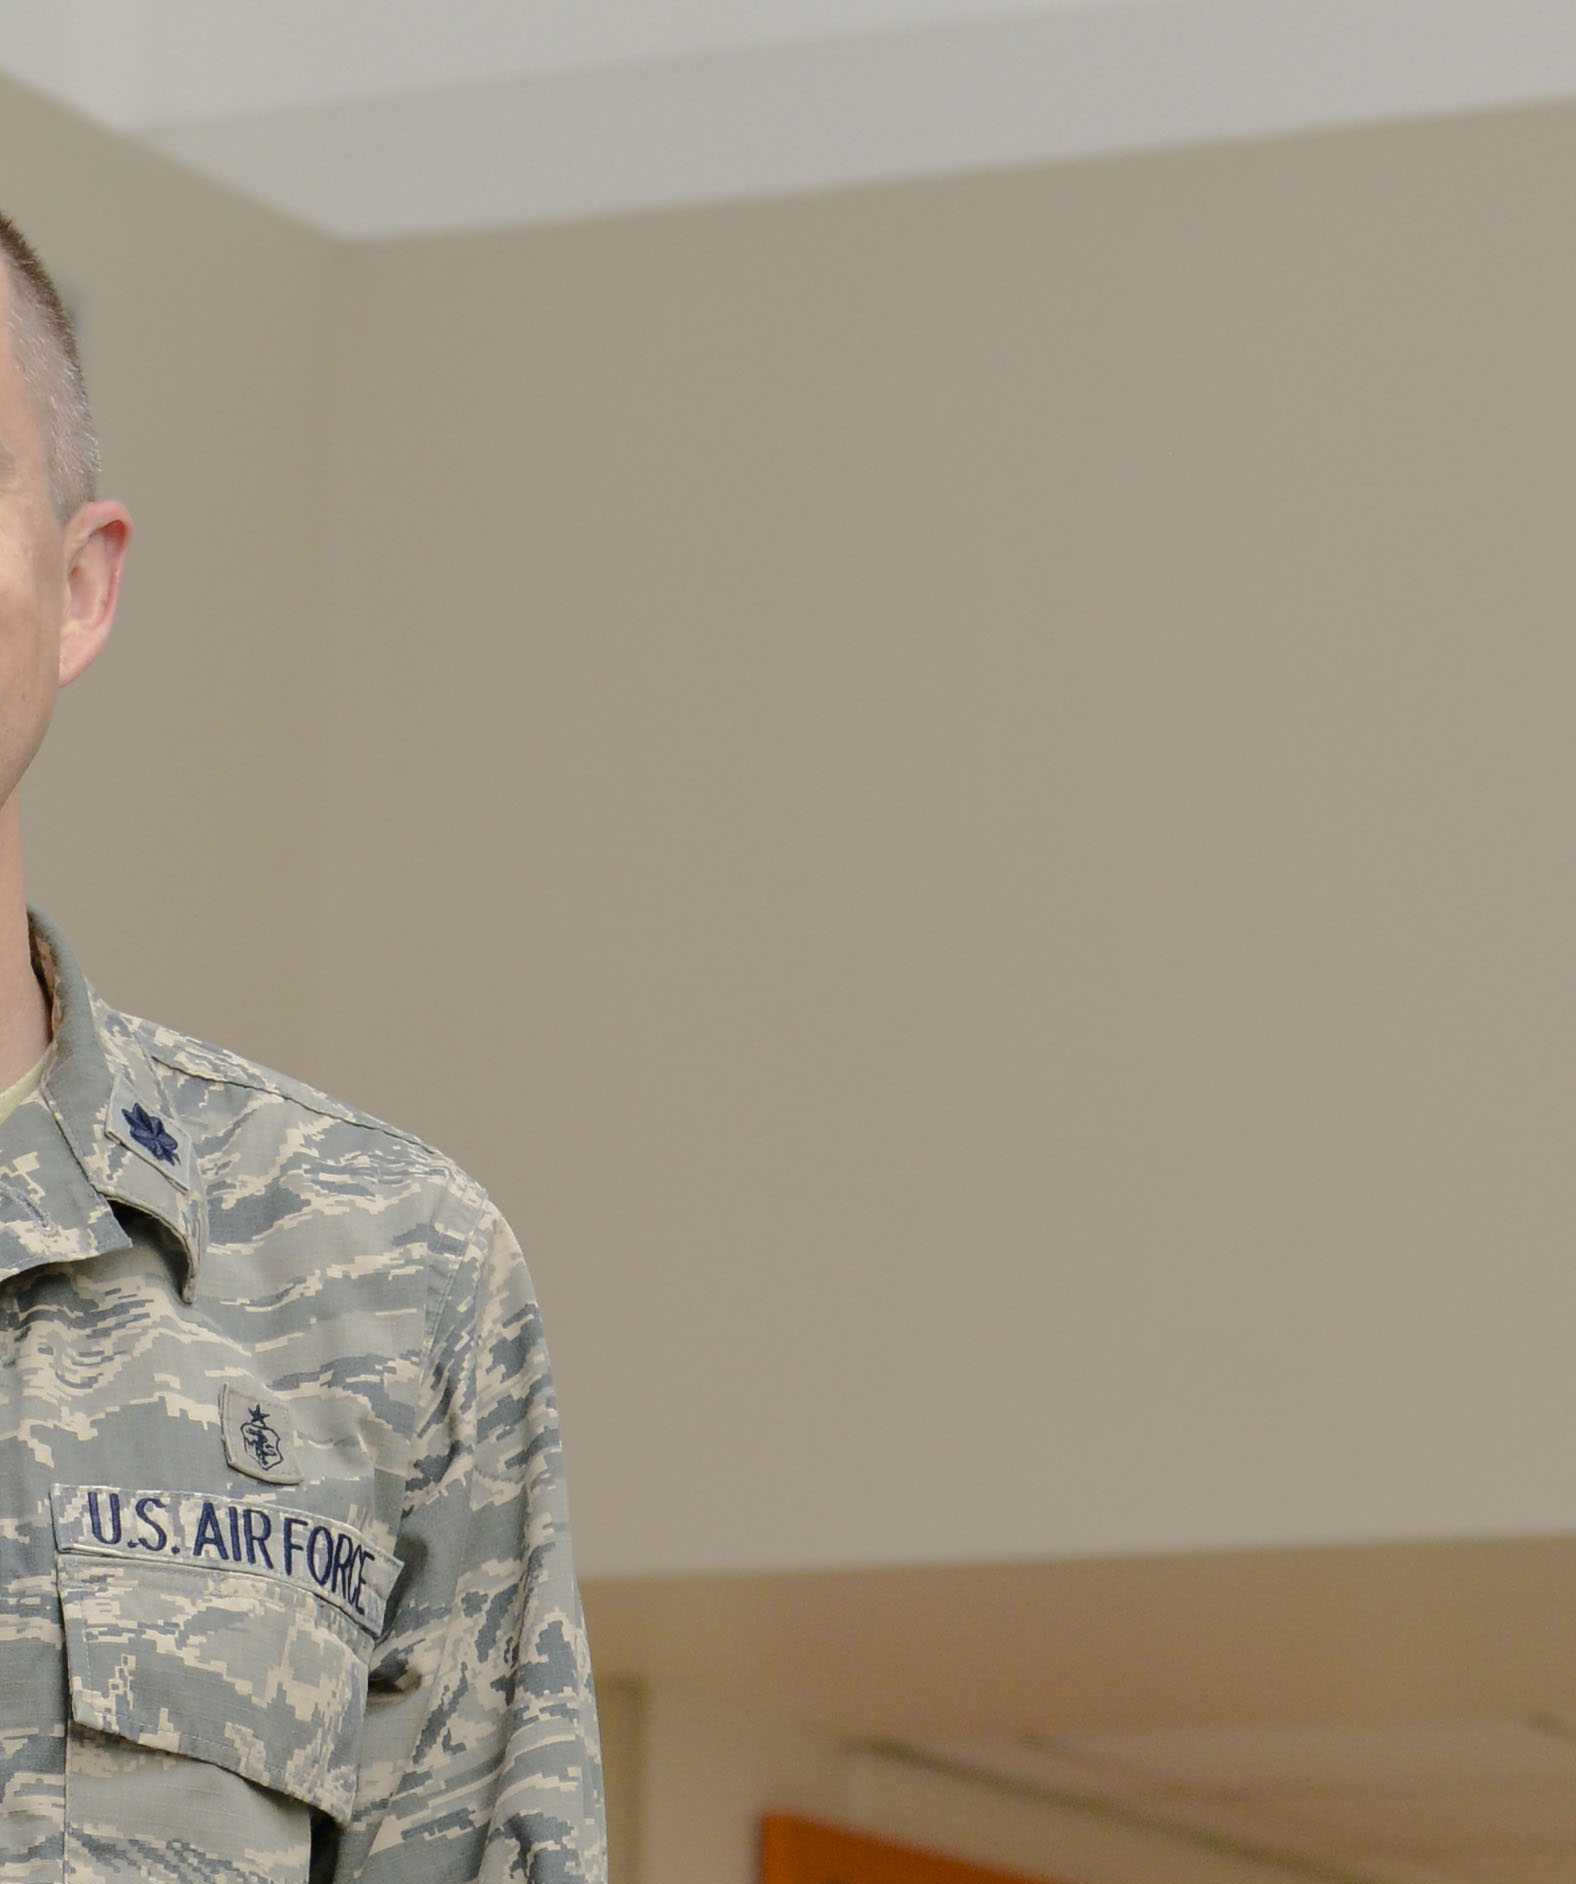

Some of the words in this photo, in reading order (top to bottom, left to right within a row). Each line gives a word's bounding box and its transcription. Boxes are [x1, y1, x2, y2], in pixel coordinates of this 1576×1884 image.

[87, 1491, 180, 1555] U.S.
[193, 1502, 274, 1569] AIR
[283, 1517, 376, 1616] FORCE
